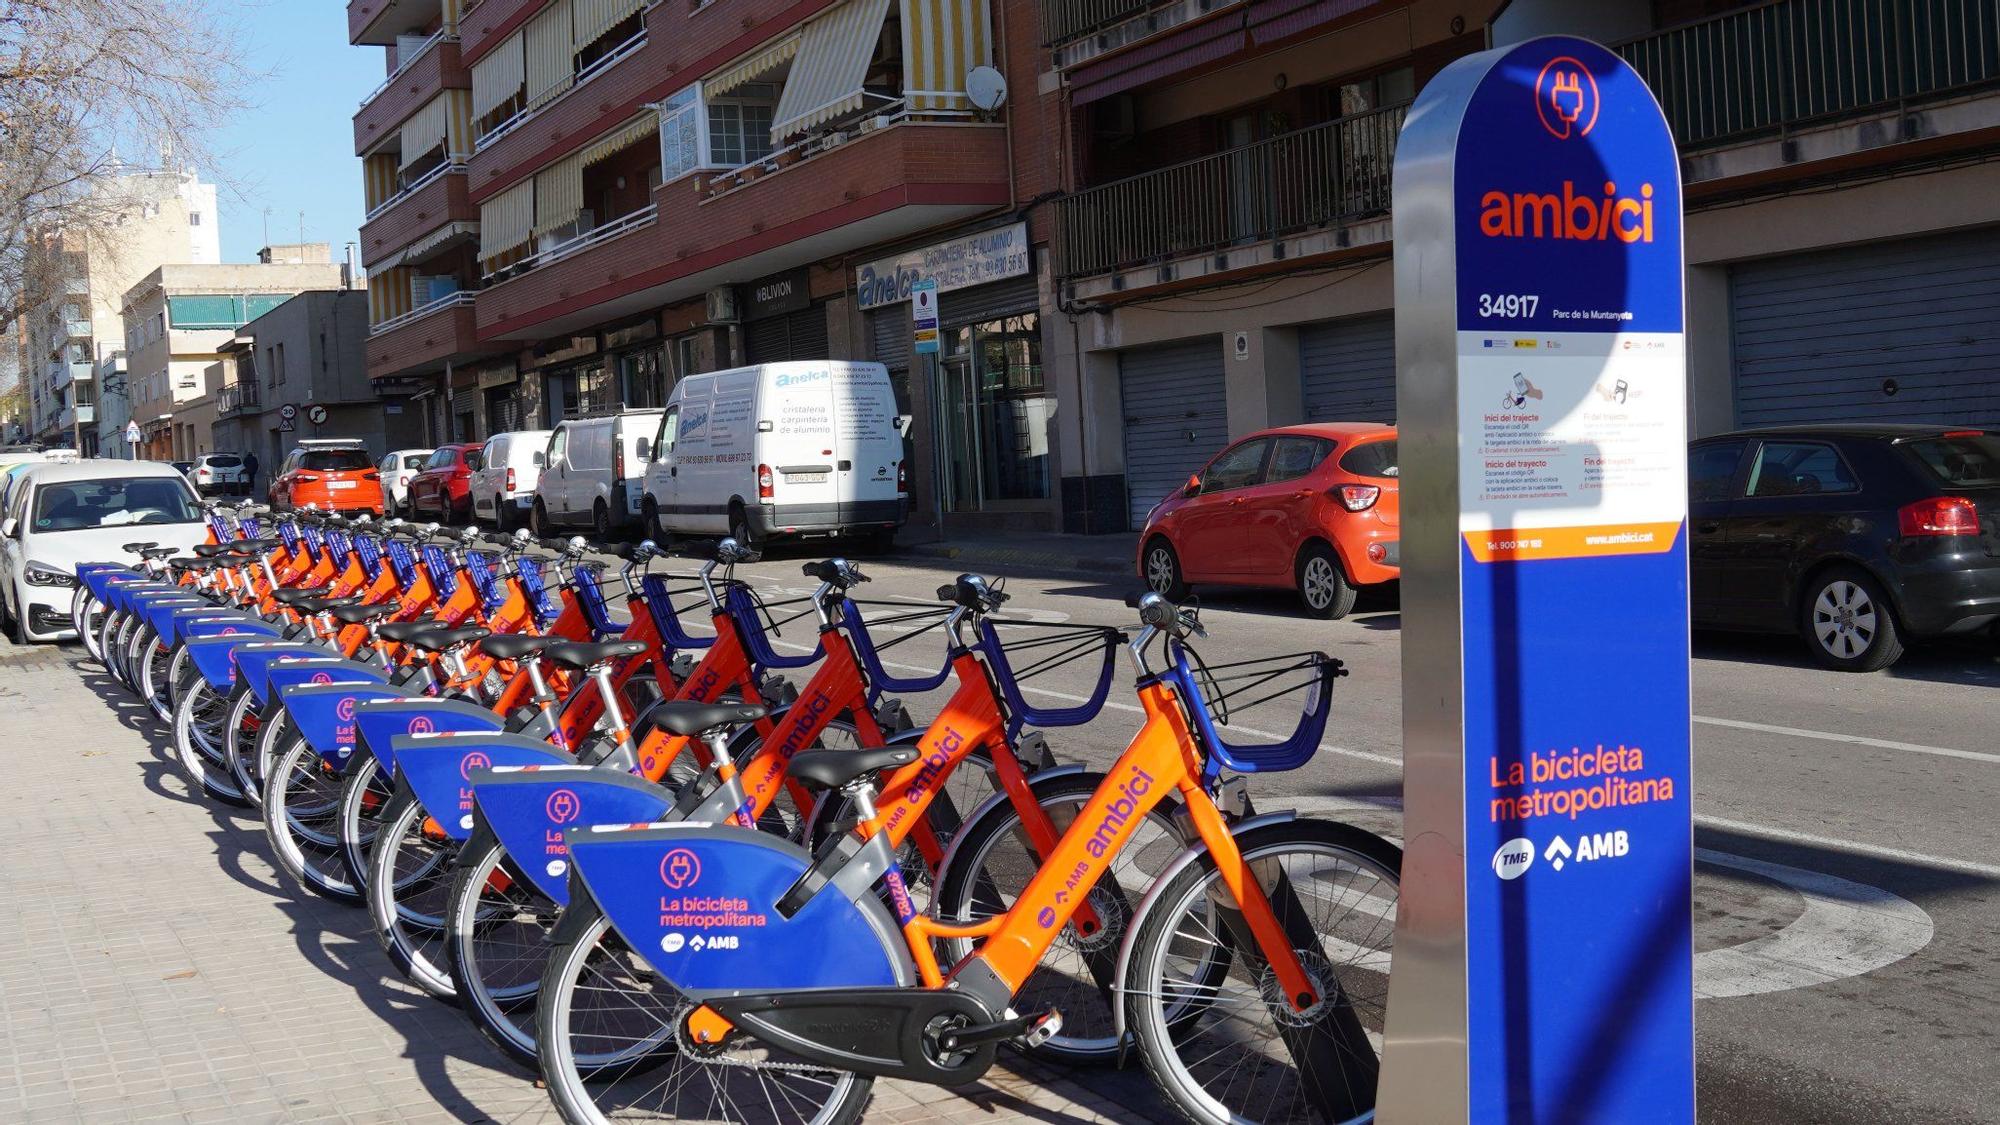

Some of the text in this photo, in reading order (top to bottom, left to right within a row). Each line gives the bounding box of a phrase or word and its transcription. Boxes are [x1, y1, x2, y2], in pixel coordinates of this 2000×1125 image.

[1479, 180, 1653, 243] ambici
[1479, 293, 1633, 321] 34917 Parc de la Muntanyeta
[1484, 413, 1499, 422] Inici
[1500, 412, 1511, 422] del
[1485, 460, 1547, 469] Inicio del trayecto
[1584, 457, 1595, 466] Fin
[1500, 540, 1516, 550] 900
[1585, 531, 1654, 546] www.ambici.cat
[779, 689, 830, 759] ambici
[763, 759, 782, 784] AMB
[904, 726, 964, 804] ambici
[1490, 744, 1643, 787] La bicicleta
[1491, 776, 1674, 822] metropolitana
[885, 806, 908, 832] AMB
[1086, 765, 1154, 859] ambici
[546, 829, 563, 842] La
[1575, 830, 1630, 863] AMB
[1502, 851, 1529, 866] TMB
[1065, 861, 1090, 891] AMB
[660, 896, 749, 912] La bicicleta
[660, 912, 767, 930] metropolitana
[707, 935, 739, 950] AMB
